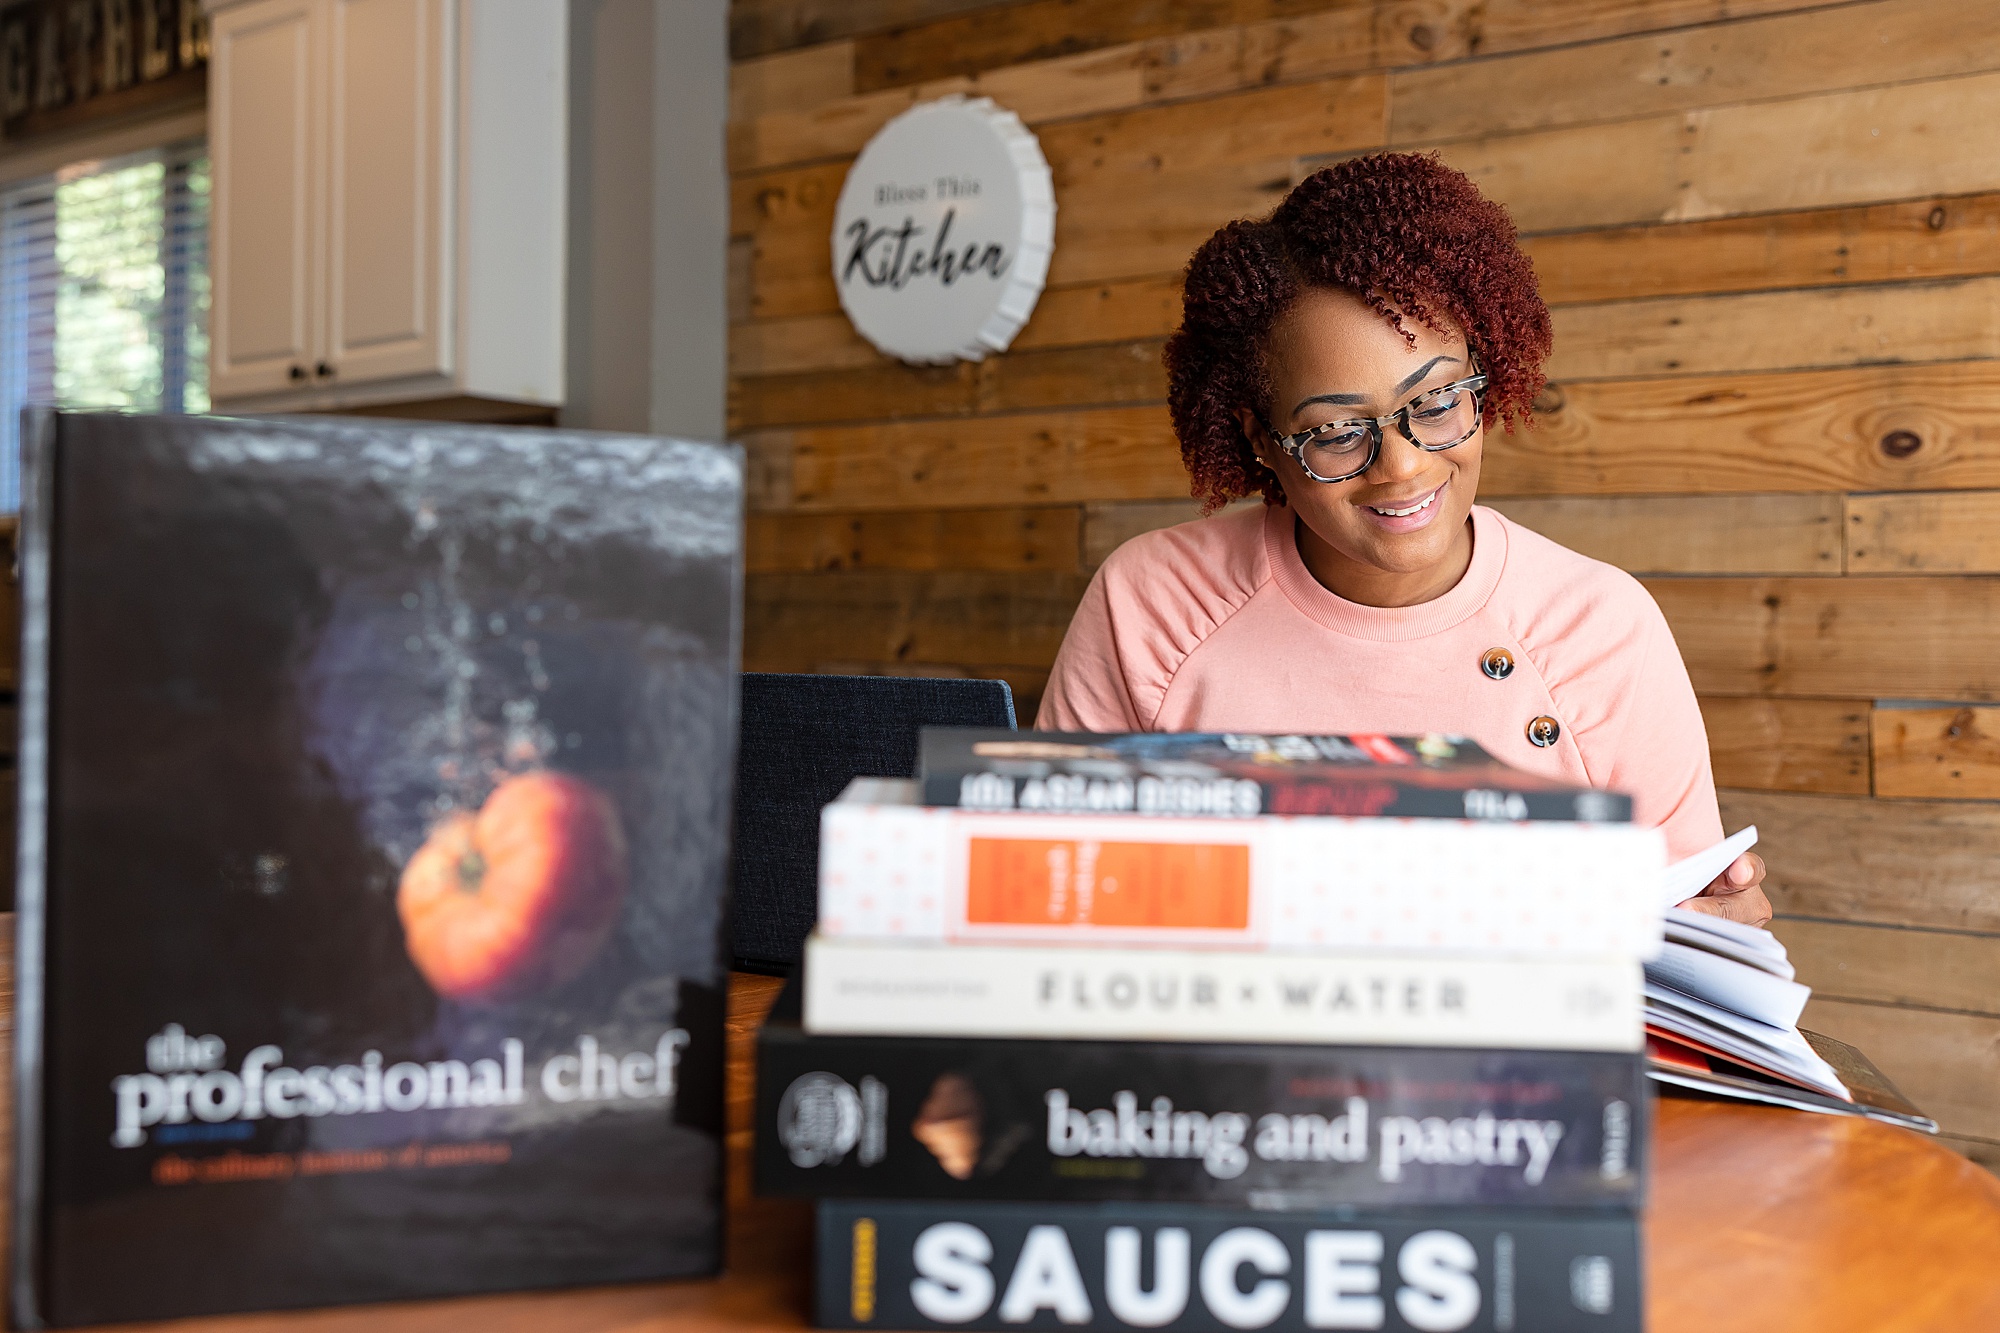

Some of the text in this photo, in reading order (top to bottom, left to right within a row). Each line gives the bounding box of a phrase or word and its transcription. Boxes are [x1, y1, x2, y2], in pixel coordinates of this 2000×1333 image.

[845, 208, 1009, 290] Kitchen
[1037, 974, 1219, 1014] FLOUR
[1278, 977, 1467, 1017] WATER
[110, 1029, 690, 1148] professional chef
[145, 1023, 226, 1073] the
[1045, 1087, 1250, 1180] baking
[1254, 1096, 1369, 1162] and
[1378, 1110, 1564, 1186] pastry
[909, 1220, 1482, 1332] SAUCES
